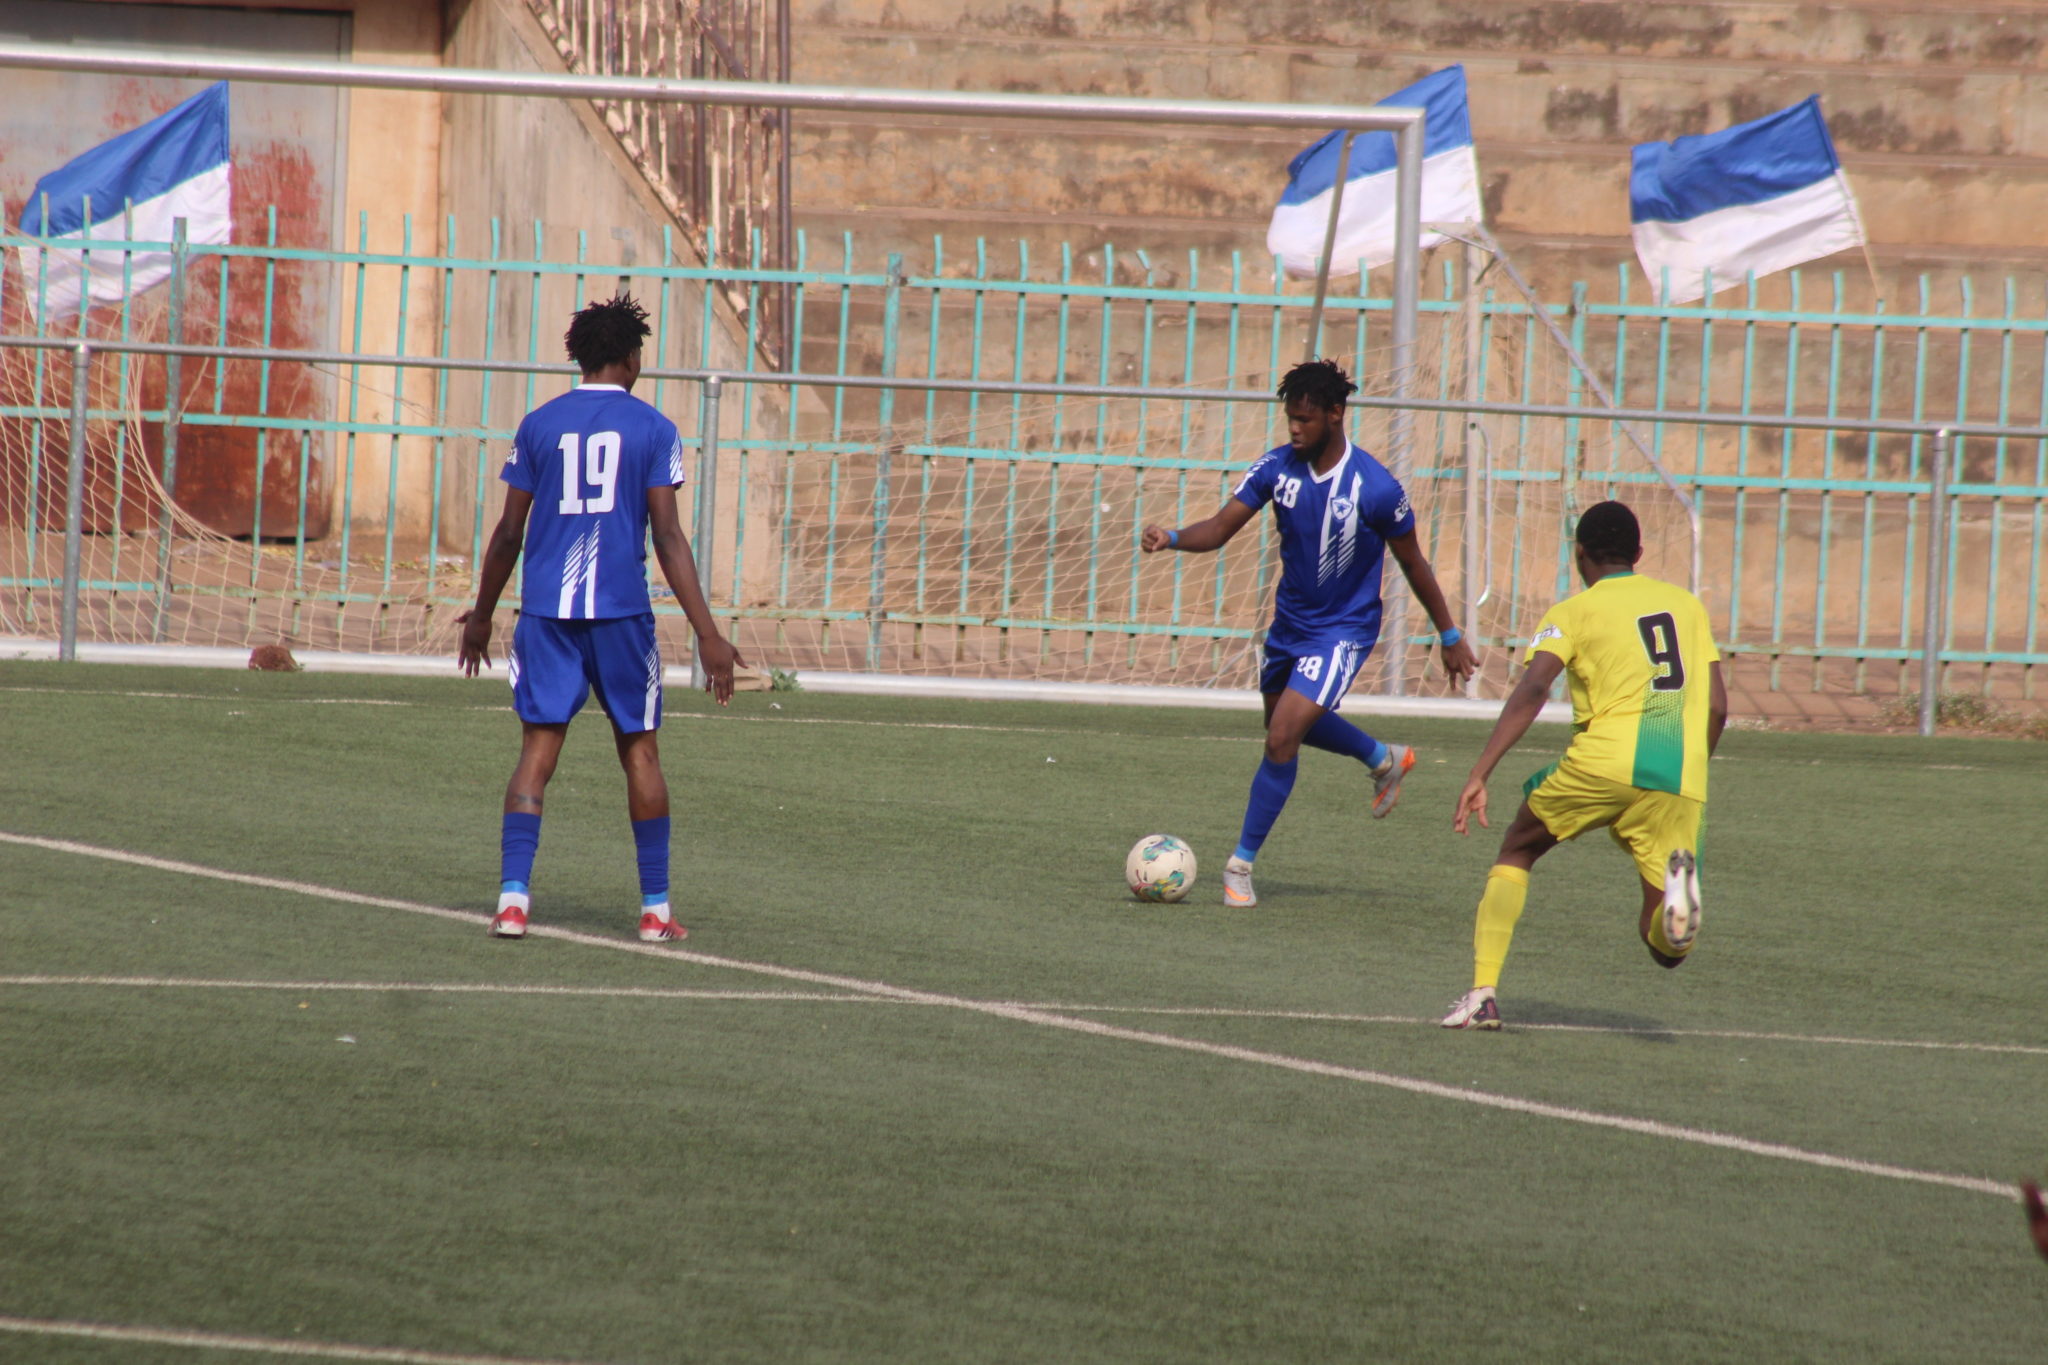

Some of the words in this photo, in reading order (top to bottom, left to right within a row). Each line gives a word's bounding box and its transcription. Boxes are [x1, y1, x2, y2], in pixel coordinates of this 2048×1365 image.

[558, 431, 620, 514] 19
[1274, 473, 1302, 508] 28
[1638, 612, 1684, 691] 9
